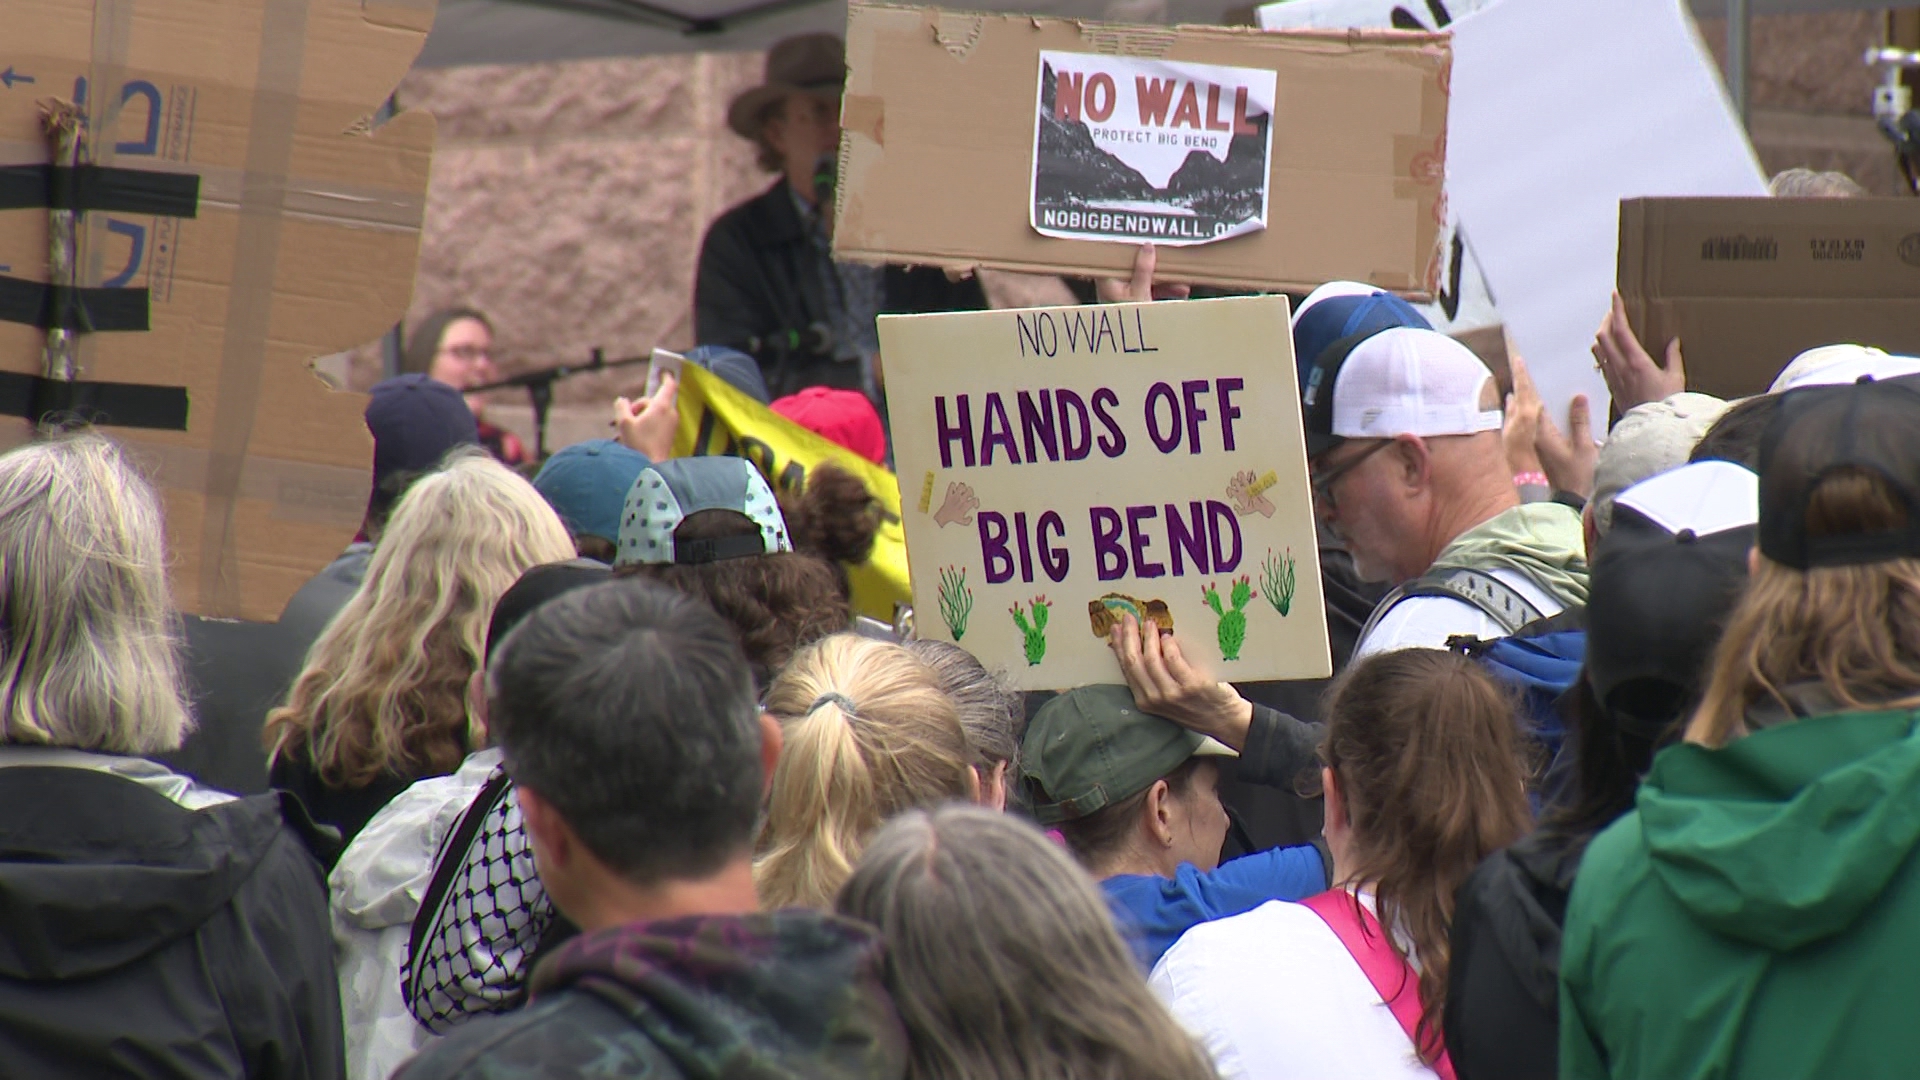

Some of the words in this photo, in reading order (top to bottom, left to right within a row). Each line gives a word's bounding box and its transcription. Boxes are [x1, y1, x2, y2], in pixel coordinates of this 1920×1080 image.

[1055, 71, 1116, 124] NO
[1135, 75, 1258, 136] WALL
[1093, 128, 1151, 144] PROTECT
[1158, 134, 1178, 146] BIG
[1184, 136, 1217, 148] BEND
[1044, 210, 1236, 237] NOBIGBENDWALL.O
[1017, 312, 1057, 357] NO
[1063, 308, 1158, 354] WALL
[934, 387, 1126, 468] HANDS
[1144, 378, 1244, 454] OFF
[977, 510, 1069, 584] BIG
[1089, 500, 1243, 581] BEND
